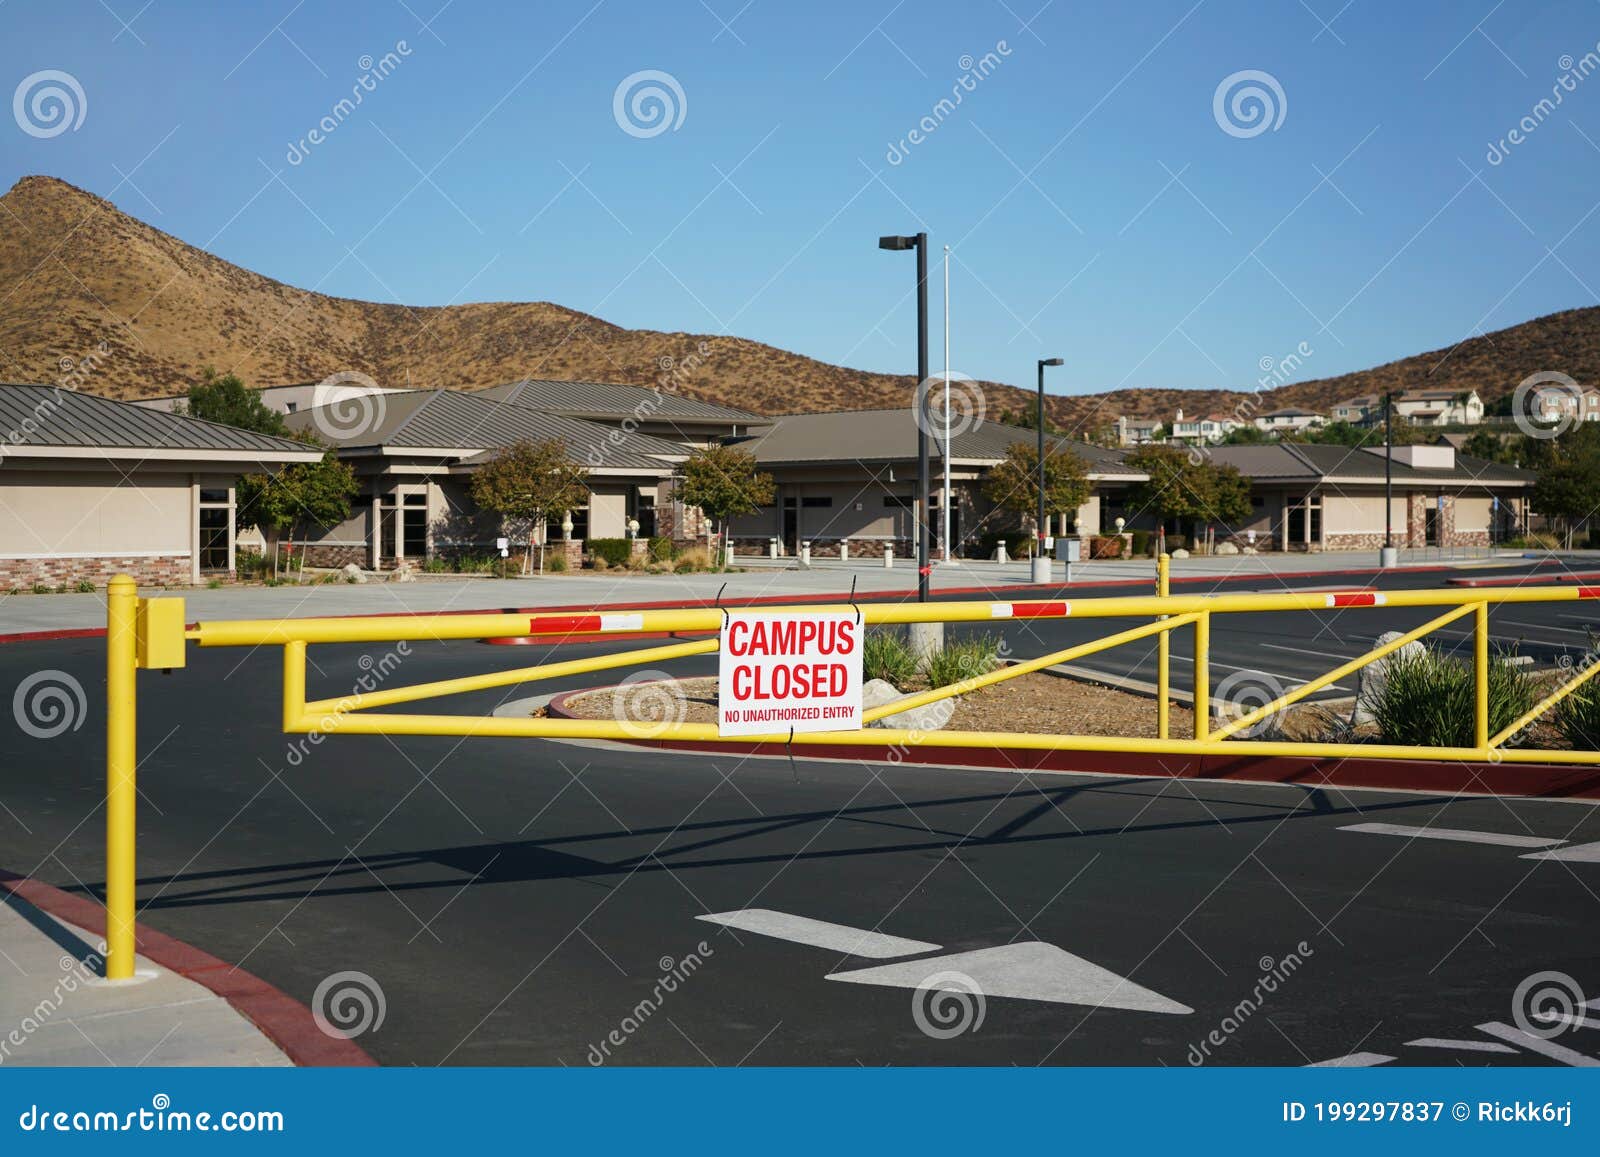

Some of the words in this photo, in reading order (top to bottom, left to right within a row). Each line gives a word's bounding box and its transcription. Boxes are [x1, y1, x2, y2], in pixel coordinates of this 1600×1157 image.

[729, 620, 855, 657] CAMPUS
[732, 664, 848, 701] CLOSED
[725, 710, 740, 723] NO
[743, 707, 820, 722] UNAUTHORIZED
[823, 706, 855, 719] ENTRY
